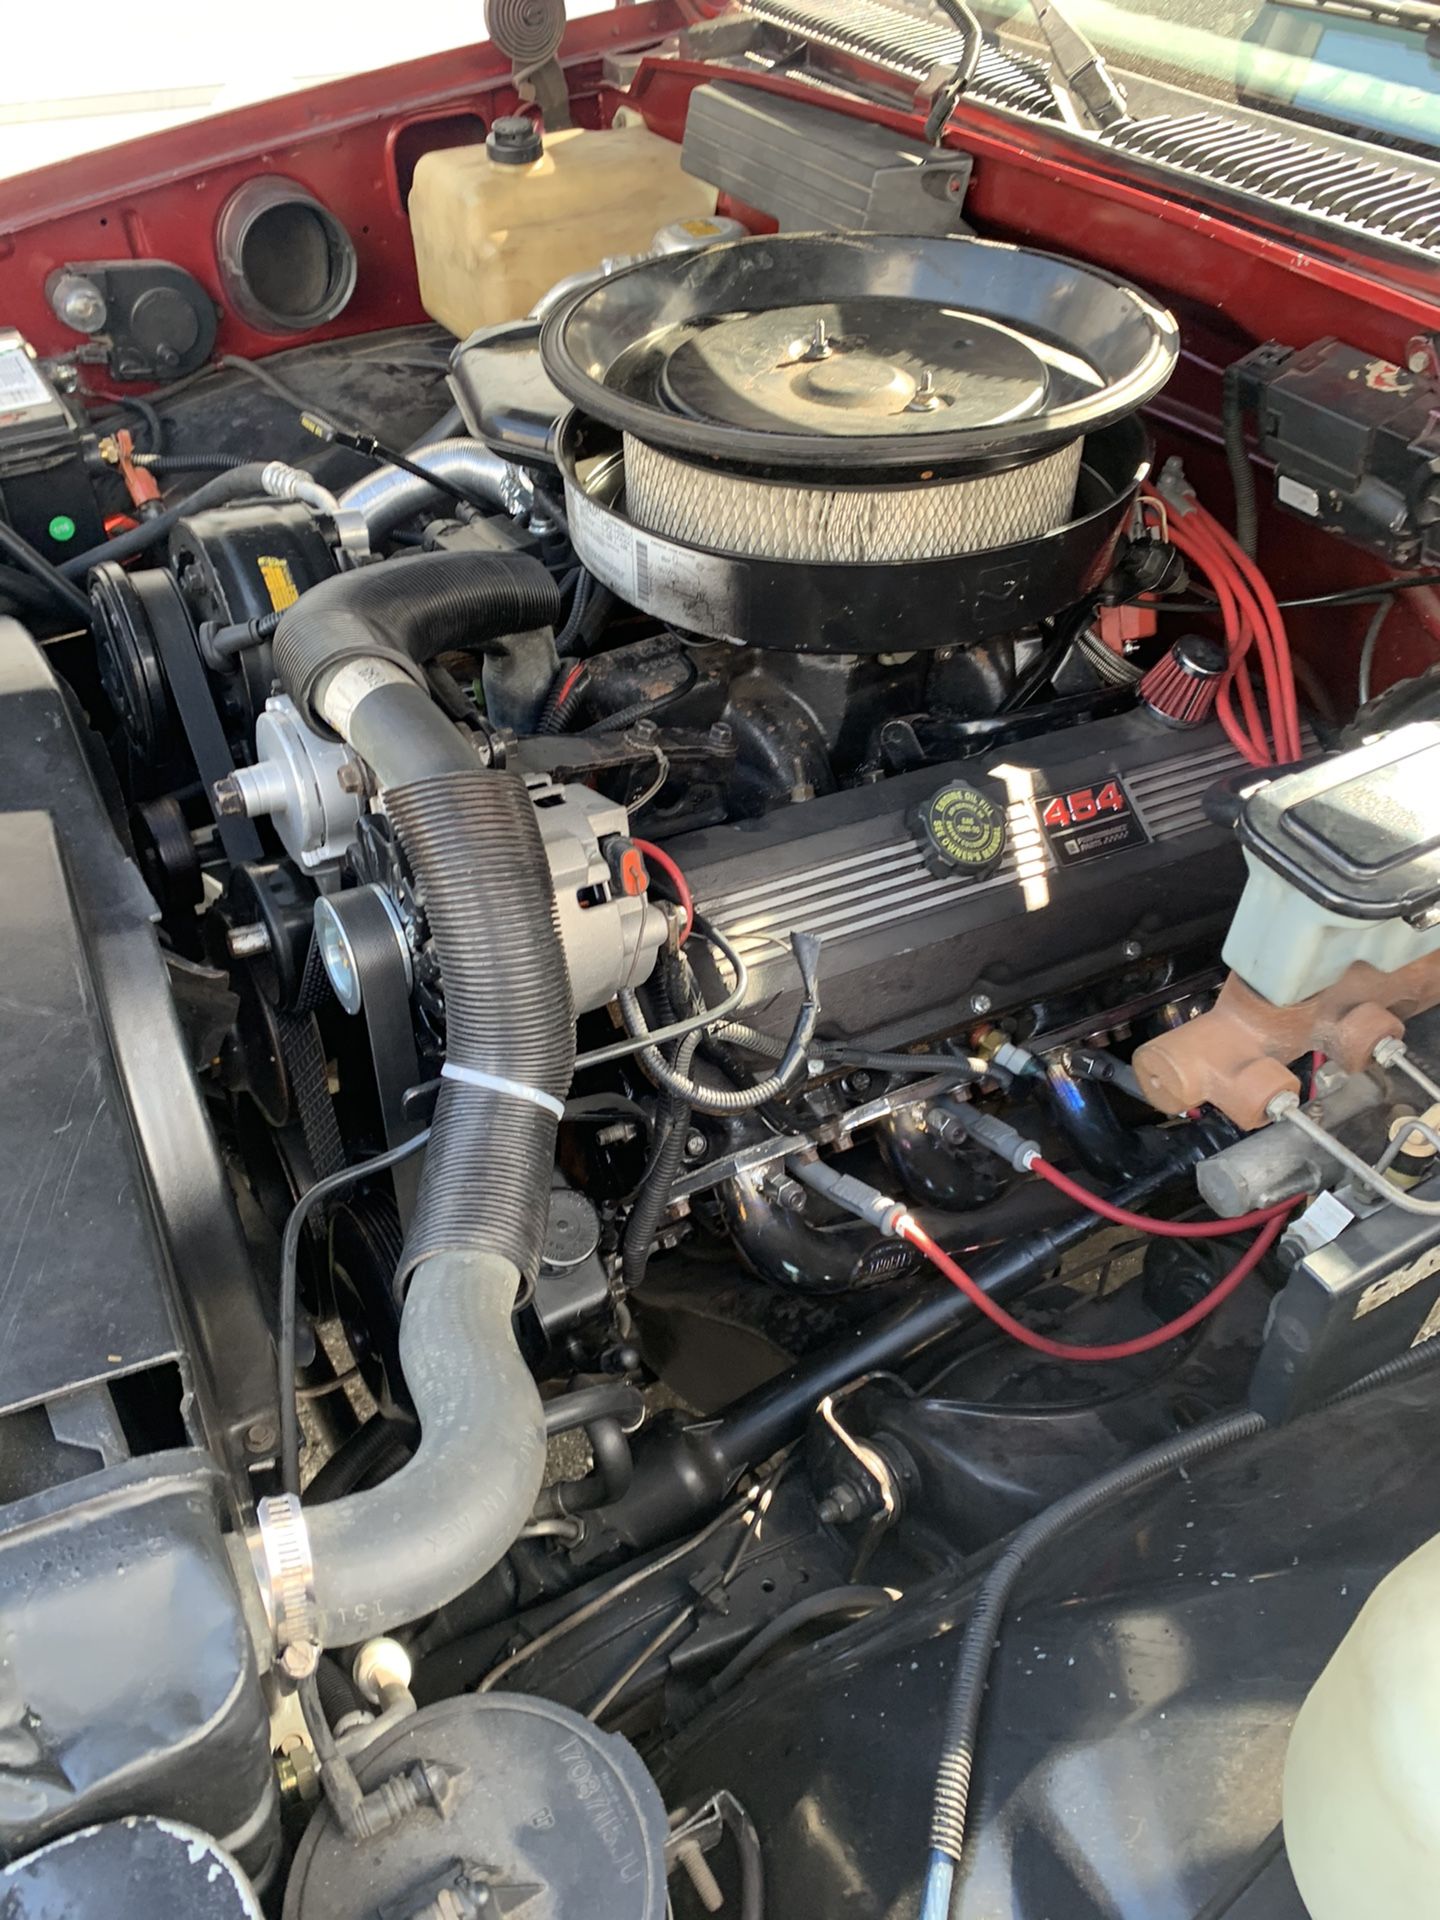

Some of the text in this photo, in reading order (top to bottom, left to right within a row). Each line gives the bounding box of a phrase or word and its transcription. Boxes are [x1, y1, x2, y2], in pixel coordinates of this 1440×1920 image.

[964, 791, 978, 804] OIL
[978, 799, 994, 817] FILL
[1043, 781, 1124, 827] 454
[933, 819, 946, 838] SEE
